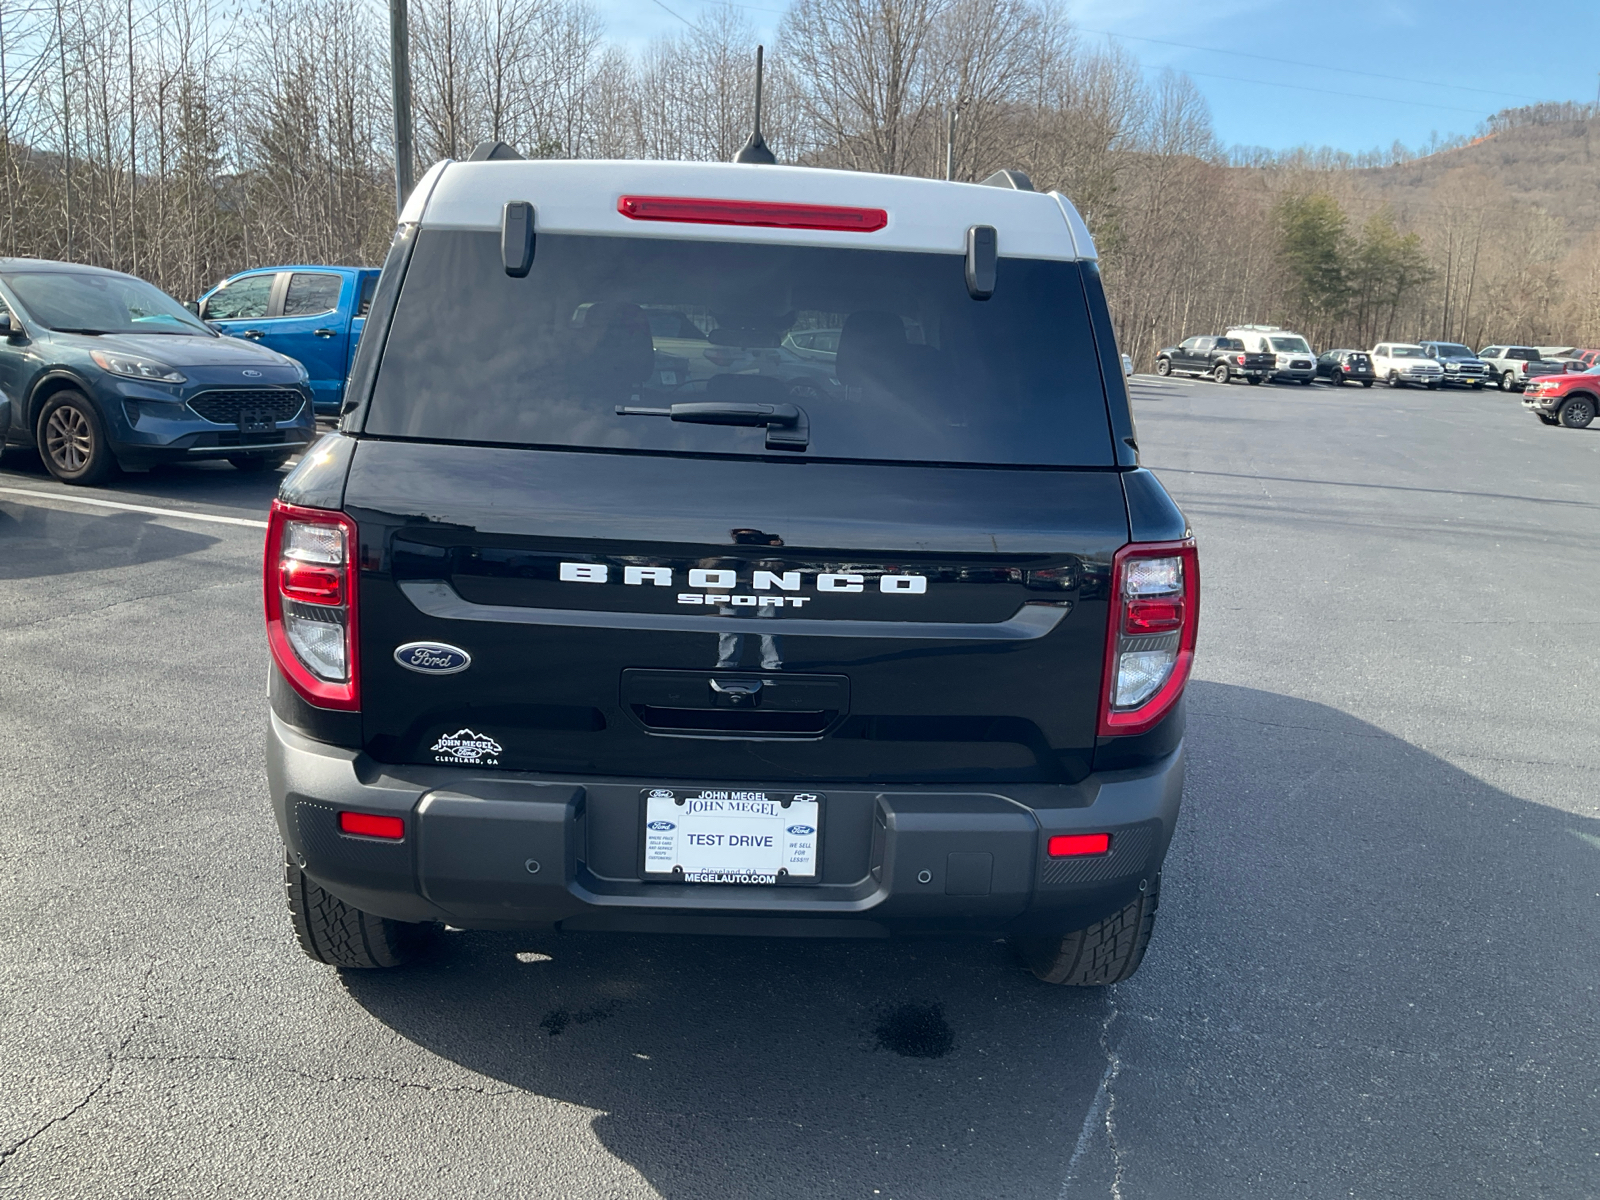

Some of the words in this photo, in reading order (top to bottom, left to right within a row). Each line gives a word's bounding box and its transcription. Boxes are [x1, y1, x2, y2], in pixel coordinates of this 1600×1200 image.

[559, 562, 927, 594] BRONCO
[677, 593, 811, 608] SPORT
[411, 648, 452, 667] Ford
[438, 739, 461, 748] JOHN
[462, 740, 493, 749] MEGEL
[435, 755, 484, 765] CLEVELAND,
[698, 791, 729, 800] JOHN
[731, 792, 769, 801] MEGEL
[686, 801, 724, 815] JOHN
[728, 801, 779, 817] MEGEL
[651, 822, 671, 830] Ford
[791, 826, 810, 834] Ford
[687, 834, 725, 846] TEST
[729, 835, 773, 847] DRIVE
[684, 874, 776, 884] MEGELAUTO.COM
